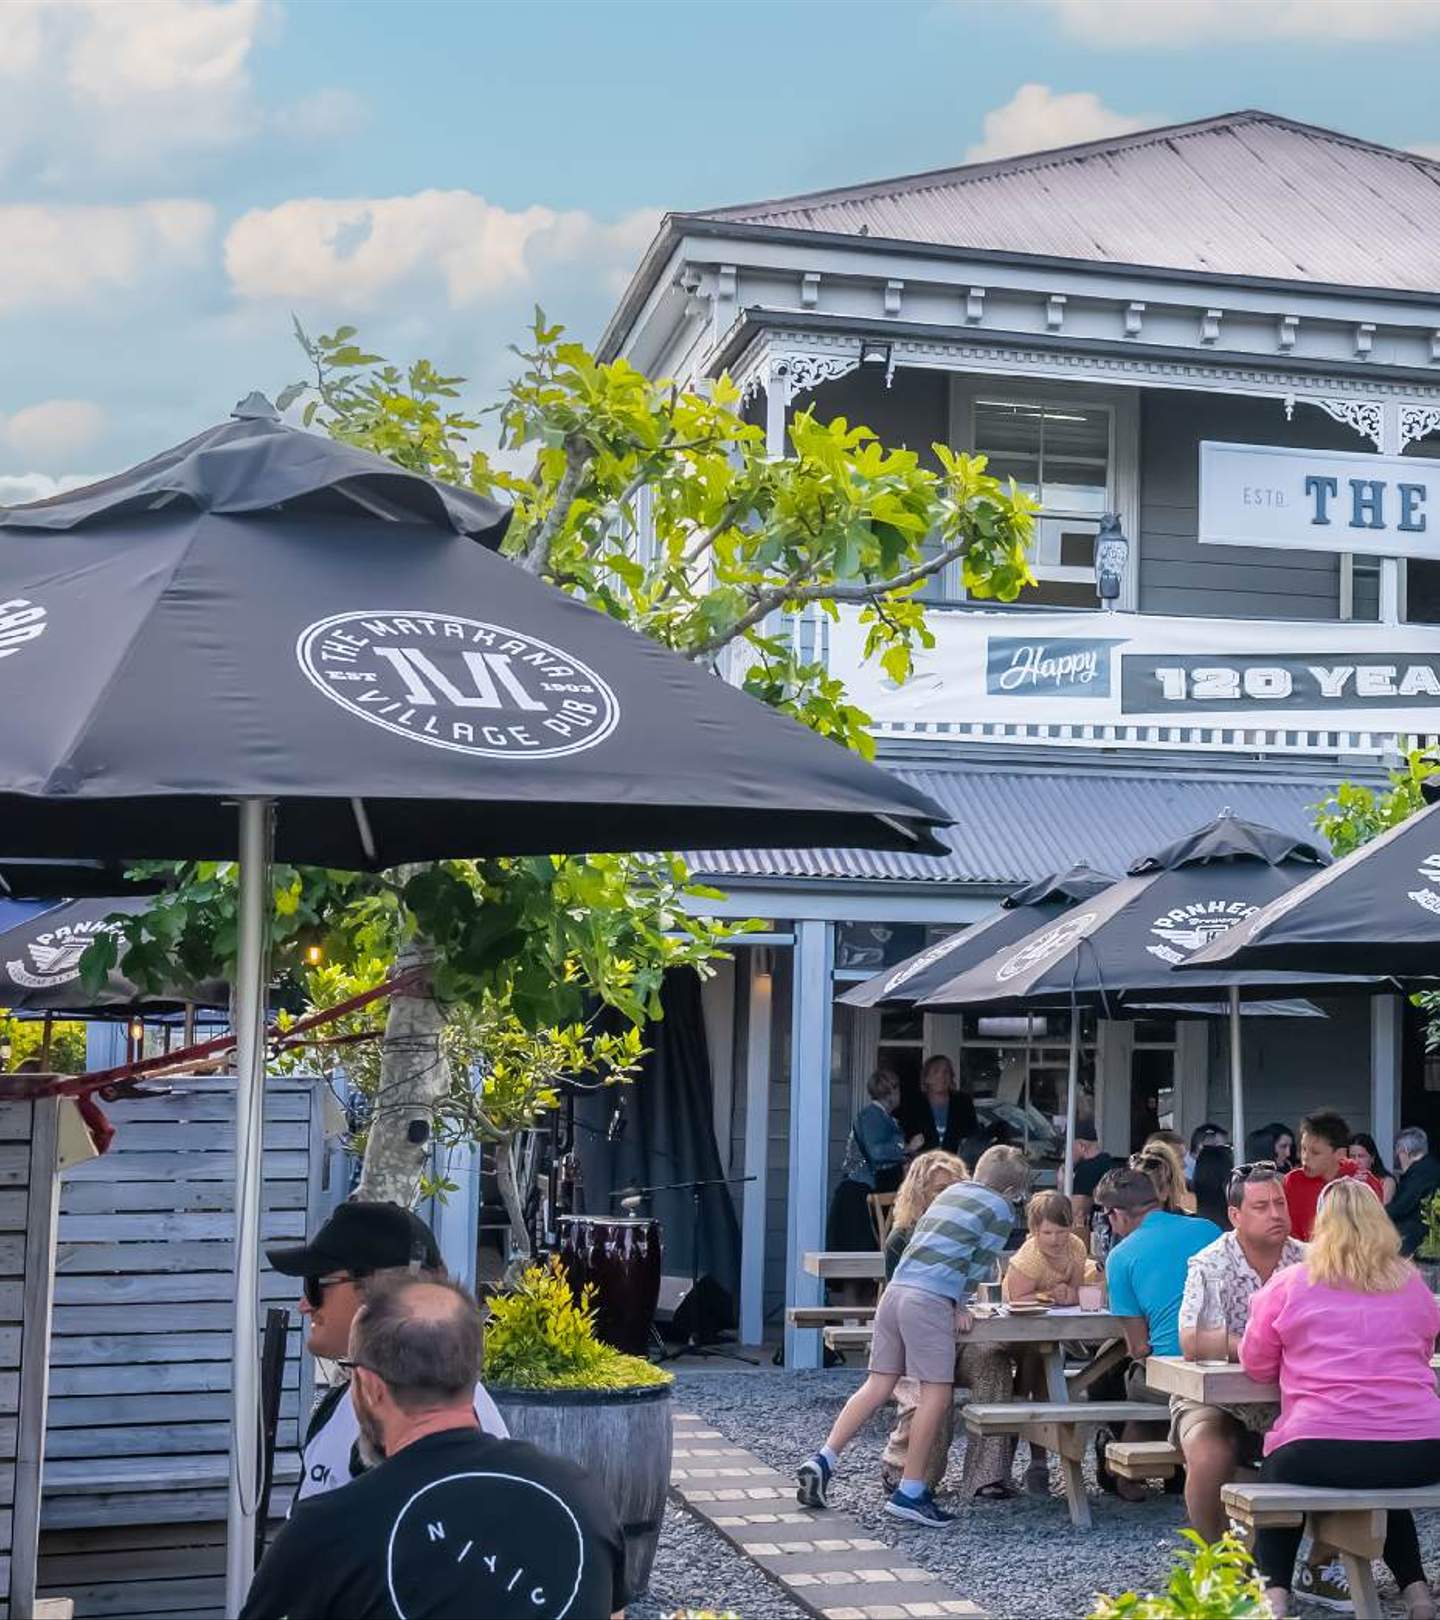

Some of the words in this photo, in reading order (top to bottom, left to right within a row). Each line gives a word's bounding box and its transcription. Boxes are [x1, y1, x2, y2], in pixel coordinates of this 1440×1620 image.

[1305, 475, 1427, 532] THE
[321, 629, 369, 663] THE
[360, 618, 575, 678] MATAKANA
[1000, 645, 1098, 689] Happy
[1154, 667, 1293, 700] 120
[325, 670, 377, 682] EST
[540, 682, 595, 693] 1903
[356, 689, 540, 746] VILLAGE
[542, 698, 598, 737] PUB
[1153, 901, 1261, 928] PANHEA
